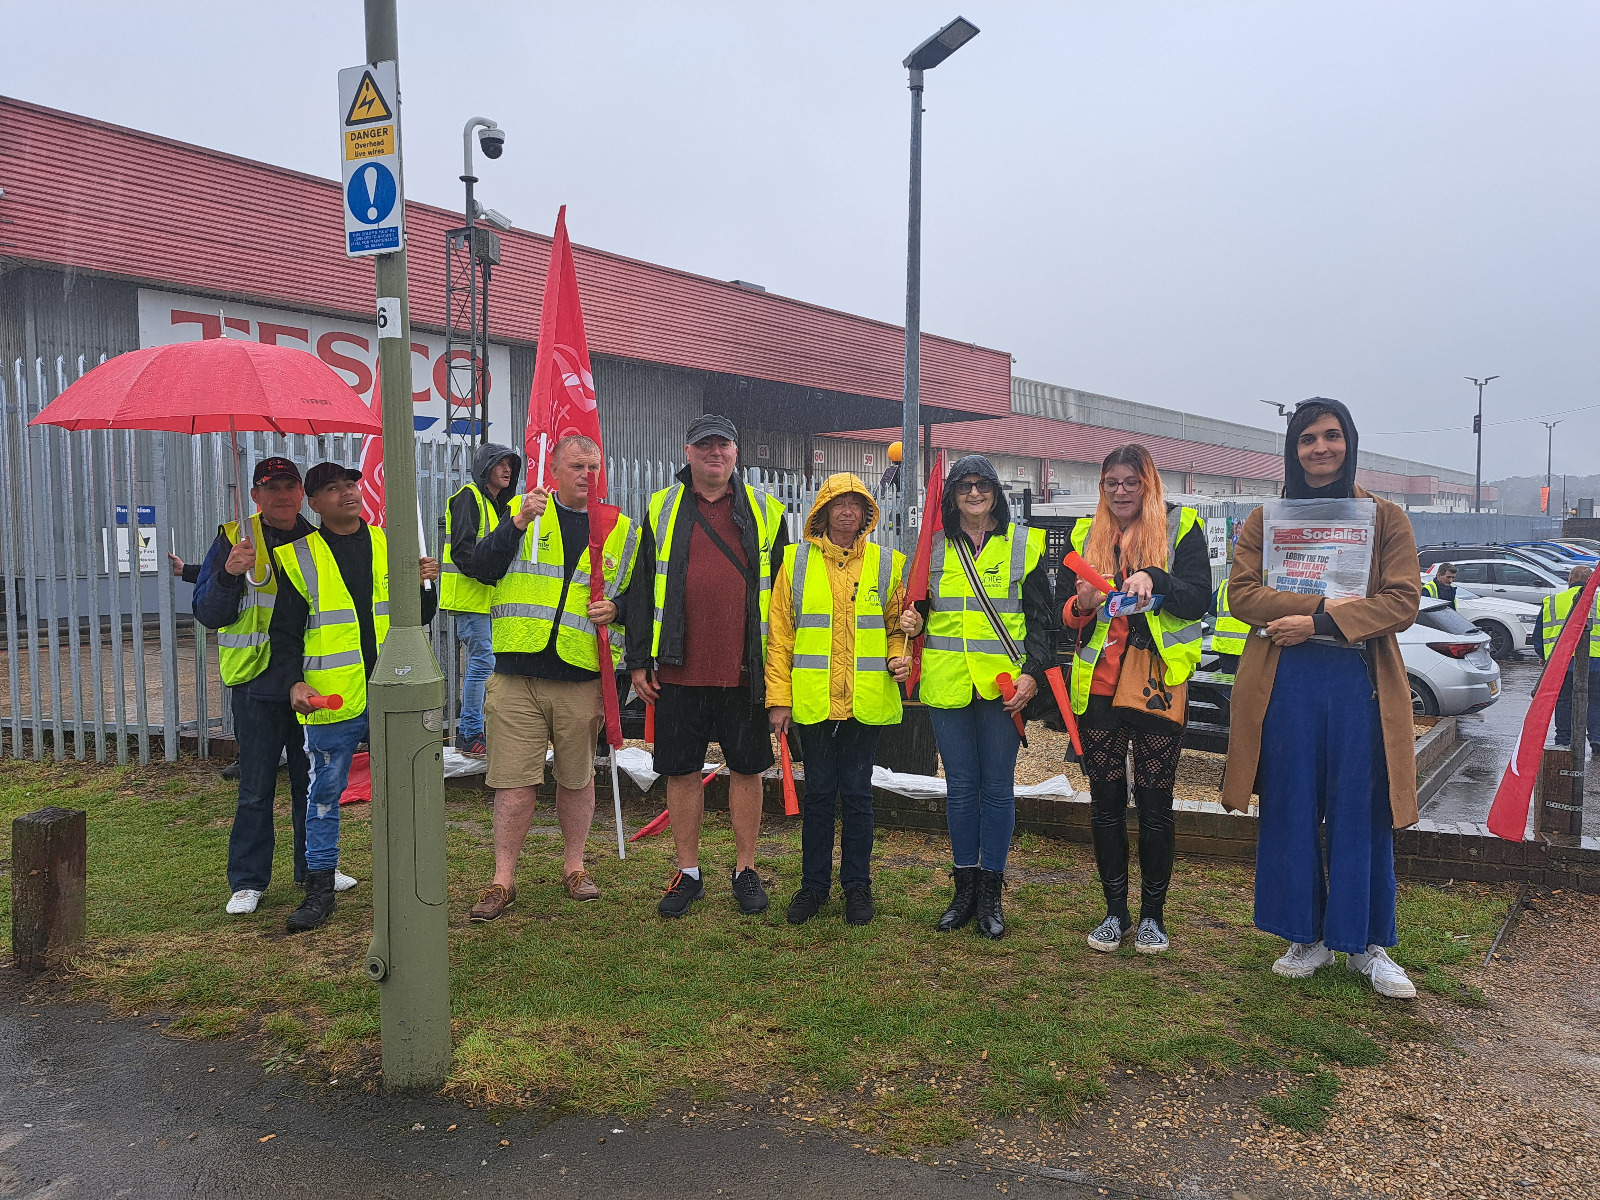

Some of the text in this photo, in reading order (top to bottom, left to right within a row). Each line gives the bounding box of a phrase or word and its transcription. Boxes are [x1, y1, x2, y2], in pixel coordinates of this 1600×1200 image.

[350, 128, 389, 142] DANGER
[354, 139, 385, 150] Overhead
[354, 148, 385, 158] live wires
[377, 306, 388, 329] 6
[814, 451, 824, 462] 60
[864, 454, 873, 465] 59
[910, 507, 917, 516] 4
[910, 517, 916, 526] 3
[1302, 528, 1368, 541] Socialist
[1285, 551, 1330, 563] LOBBY THE TUC
[1282, 560, 1328, 572] FIGHT THE ANTI-
[982, 574, 1003, 584] nite
[1286, 568, 1322, 580] UNION LAWS
[1276, 576, 1327, 589] DEFEND JOBS AND
[1275, 584, 1296, 592] PUBLIC
[1296, 587, 1326, 596] SERVICES
